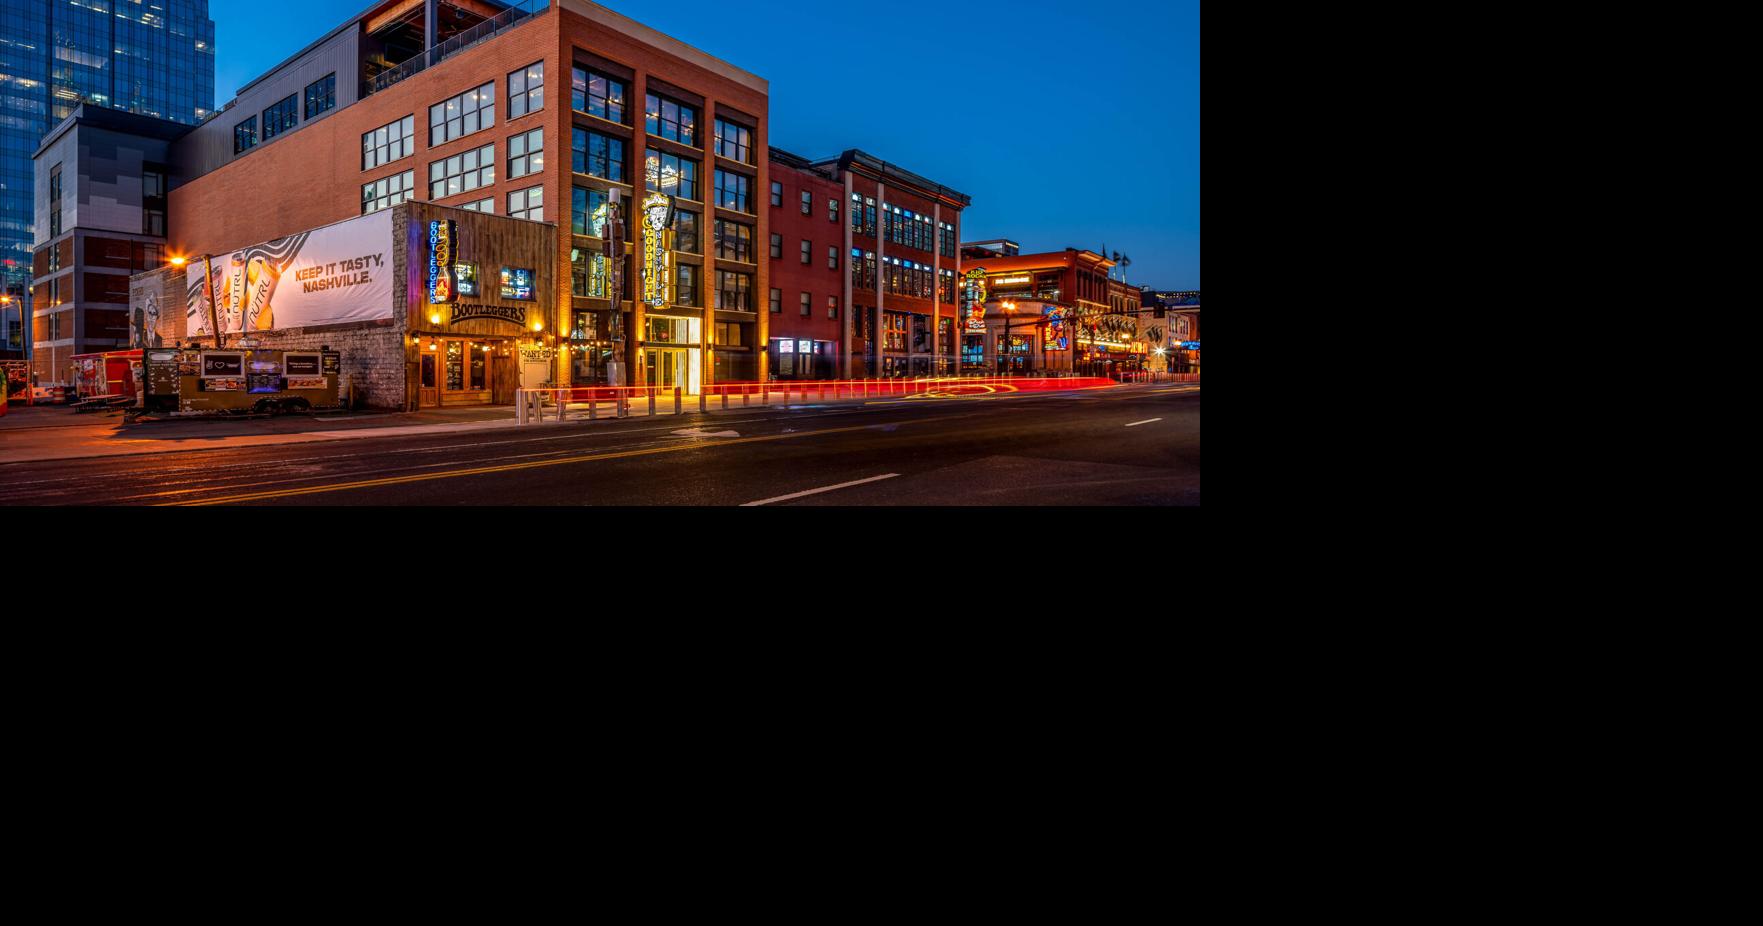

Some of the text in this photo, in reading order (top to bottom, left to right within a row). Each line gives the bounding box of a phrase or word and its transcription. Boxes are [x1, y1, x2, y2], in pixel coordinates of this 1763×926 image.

[295, 253, 384, 282] KEEP IT TASTY,
[430, 221, 438, 304] BOOTLEGGERS
[303, 271, 373, 293] NASHVILLE.
[451, 302, 526, 322] BOOTLEGGERS
